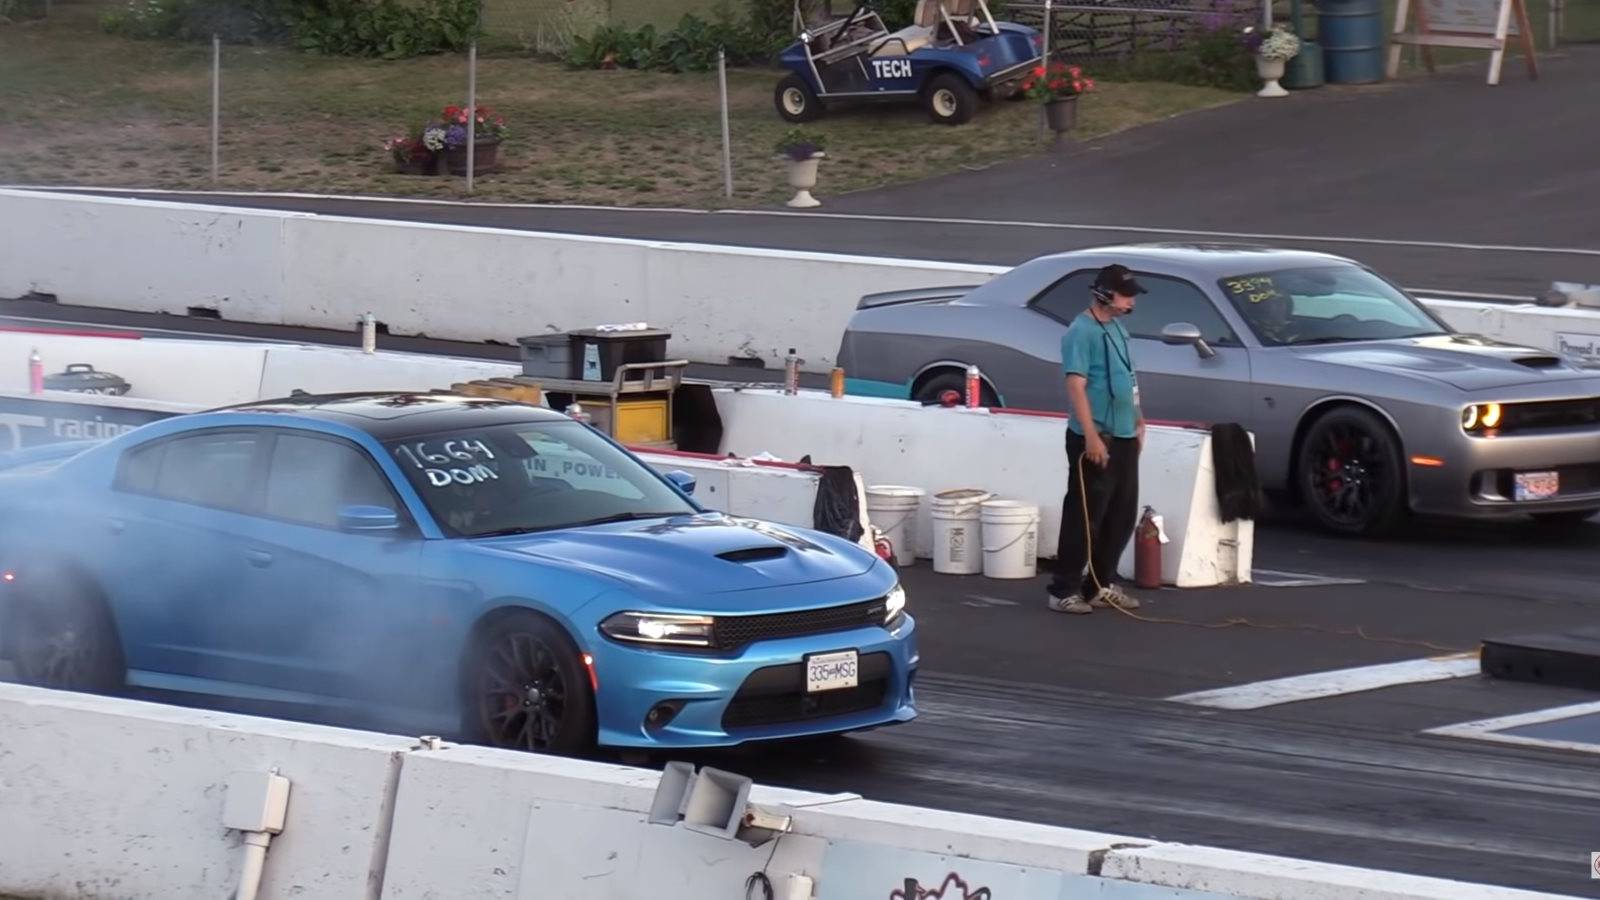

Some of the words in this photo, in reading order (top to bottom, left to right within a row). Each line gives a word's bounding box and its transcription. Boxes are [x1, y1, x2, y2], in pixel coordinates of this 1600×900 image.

[872, 60, 912, 78] TECH
[396, 440, 495, 468] 1664
[425, 464, 498, 486] DOM
